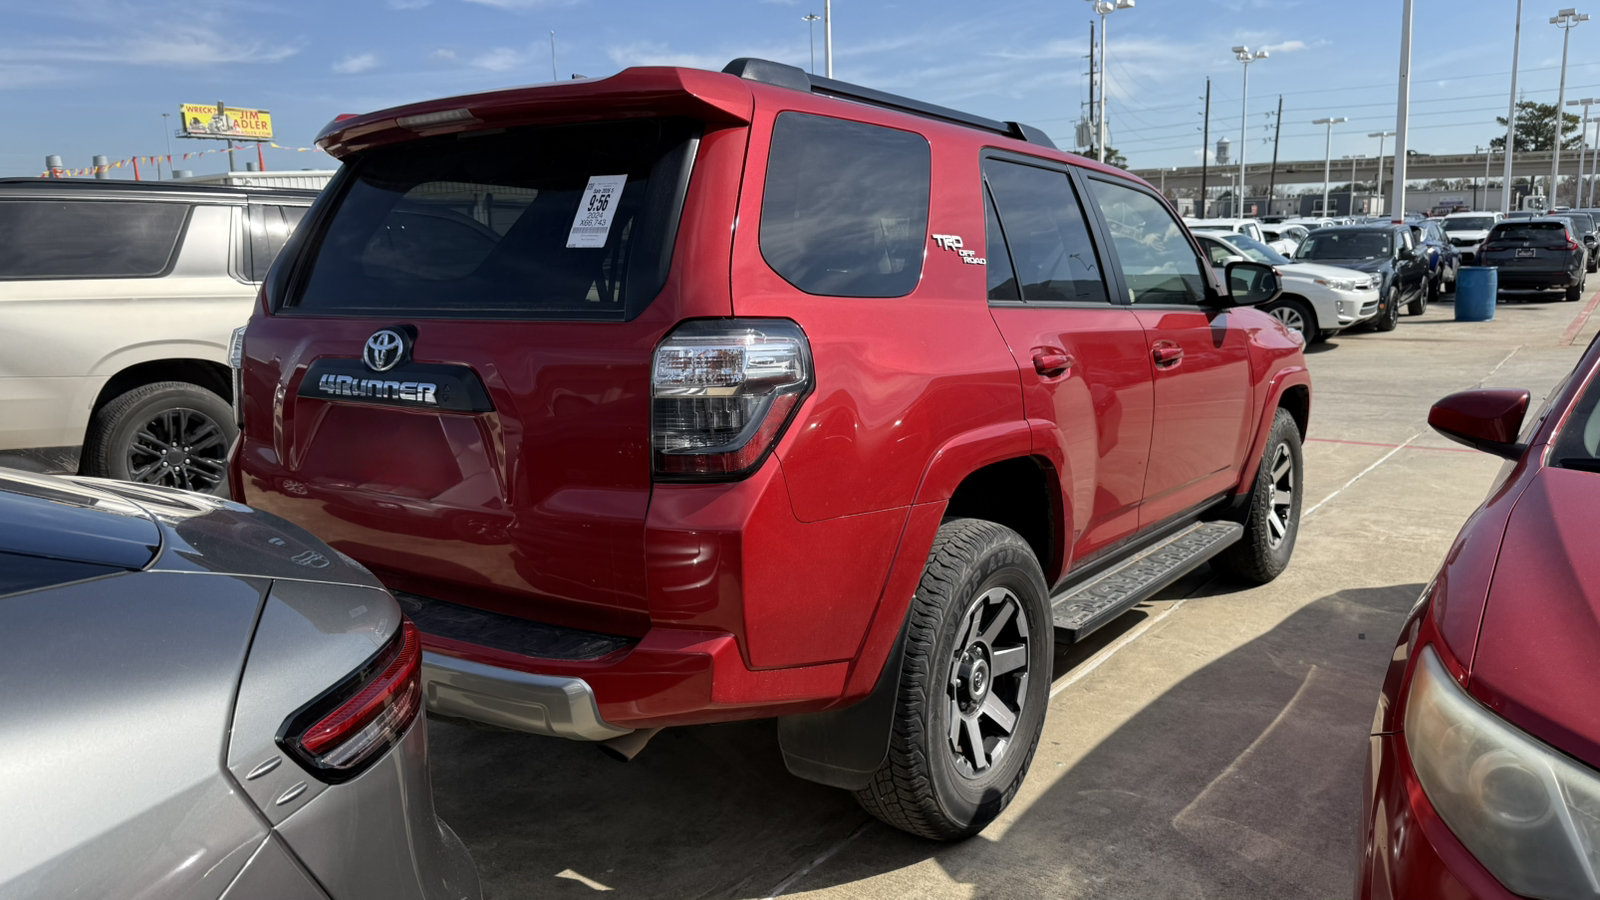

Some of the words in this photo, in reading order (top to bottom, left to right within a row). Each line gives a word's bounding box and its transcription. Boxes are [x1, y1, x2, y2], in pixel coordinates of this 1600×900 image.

[186, 105, 217, 114] WRECK?
[240, 111, 259, 120] JIM
[233, 119, 268, 130] ADLER
[588, 194, 610, 212] 9:56
[931, 234, 963, 251] TRD
[962, 256, 987, 265] ROAD
[319, 373, 438, 404] 4RUNNER
